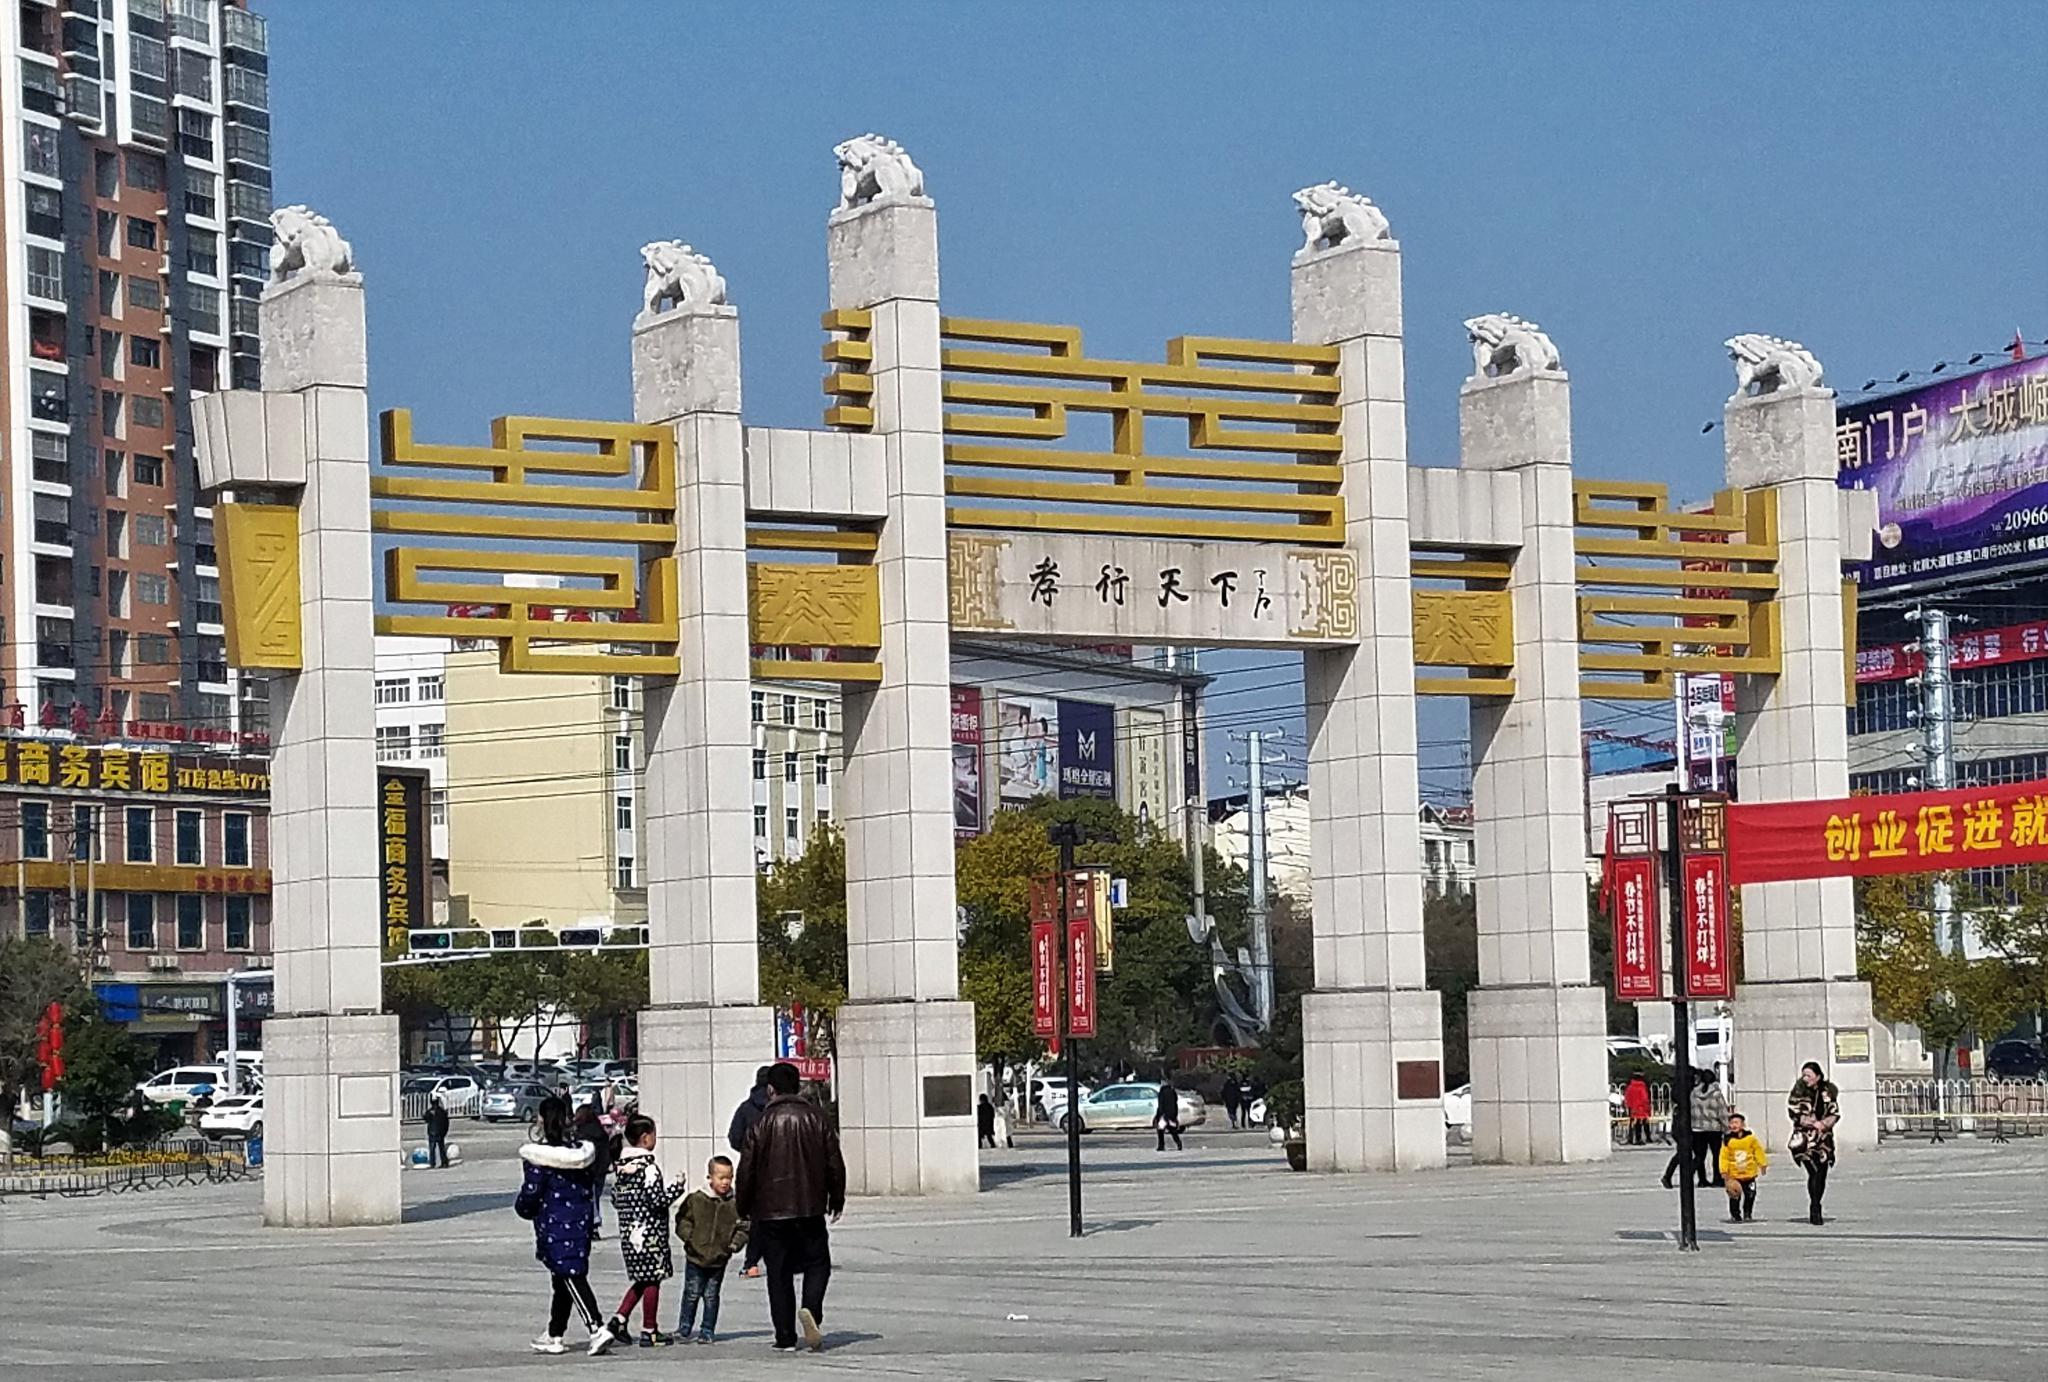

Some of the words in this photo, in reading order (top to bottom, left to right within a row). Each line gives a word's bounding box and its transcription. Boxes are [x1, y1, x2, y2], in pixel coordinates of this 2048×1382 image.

[1028, 556, 1239, 607] 孝行天下
[0, 740, 170, 793] 商务宾馆
[1824, 794, 2048, 861] 创业促进就
